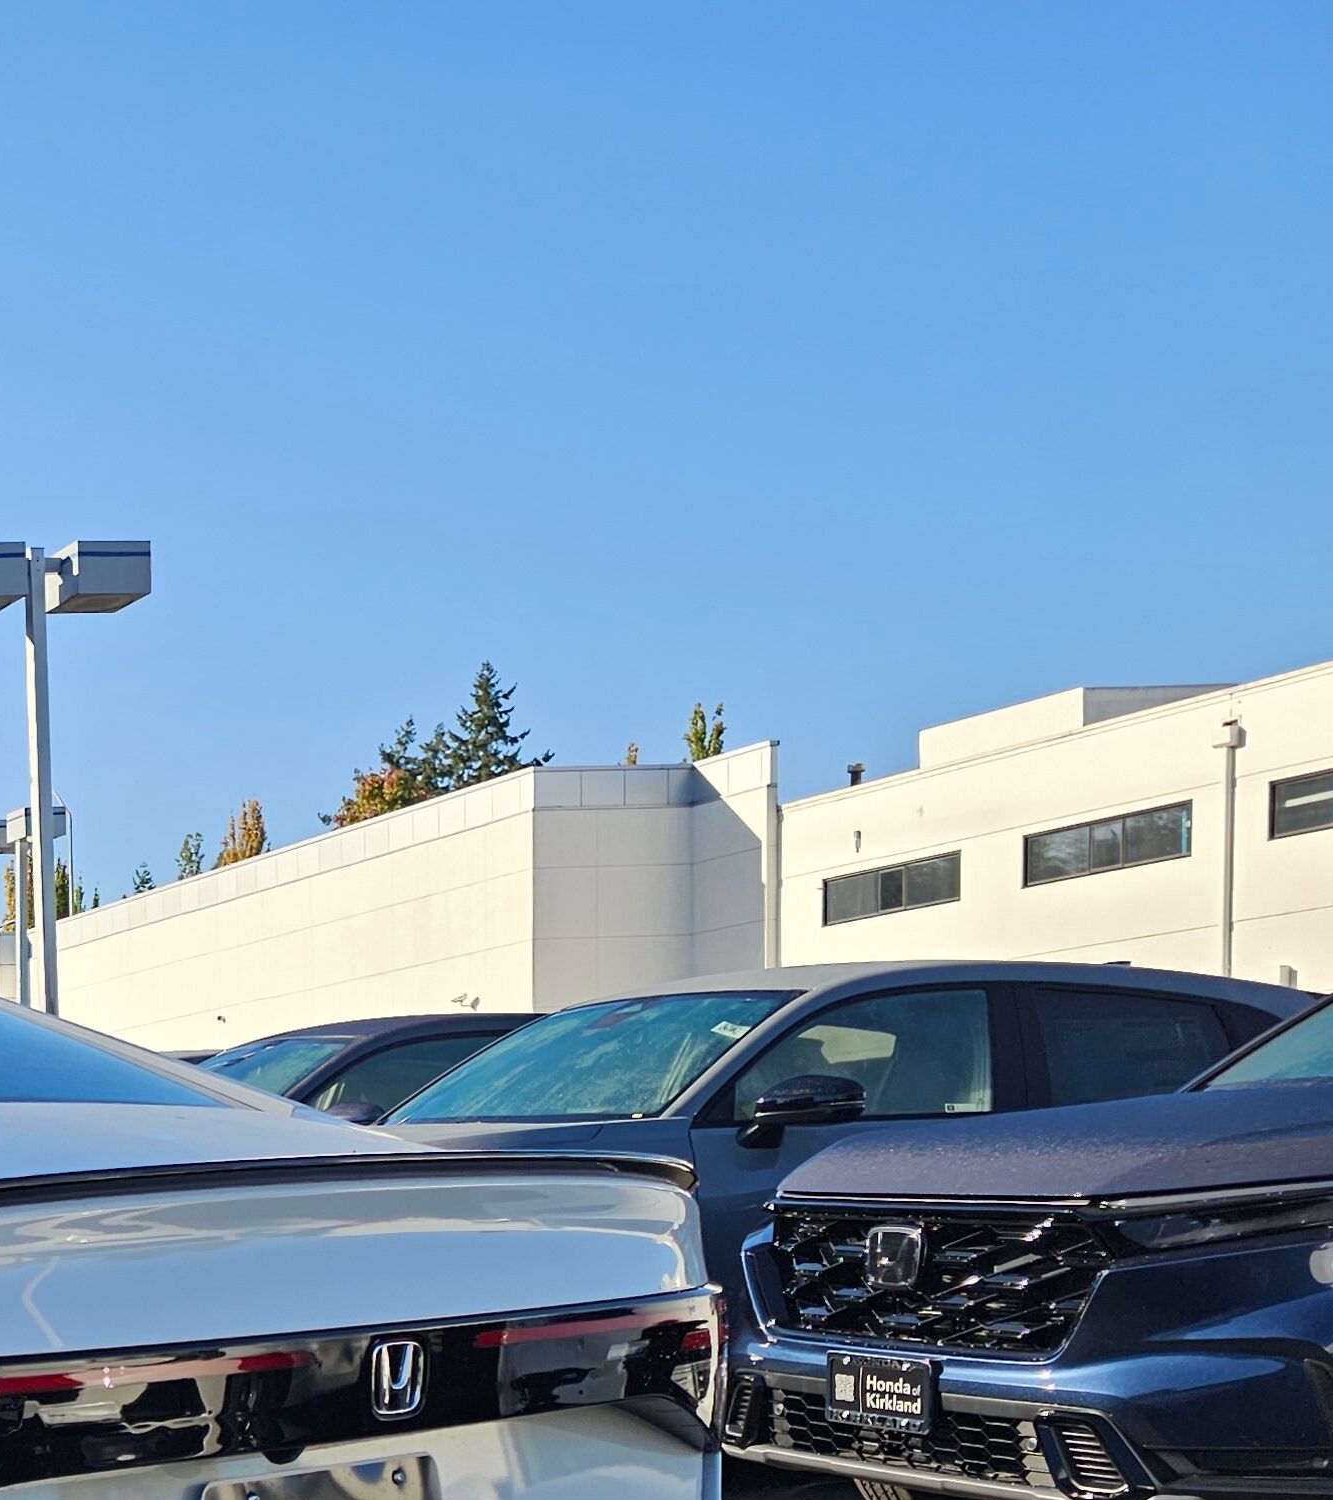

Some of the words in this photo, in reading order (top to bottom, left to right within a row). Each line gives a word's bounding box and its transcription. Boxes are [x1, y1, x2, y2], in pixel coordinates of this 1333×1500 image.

[866, 1374, 911, 1396] Honda
[911, 1384, 921, 1396] of
[866, 1393, 922, 1415] Kirkland
